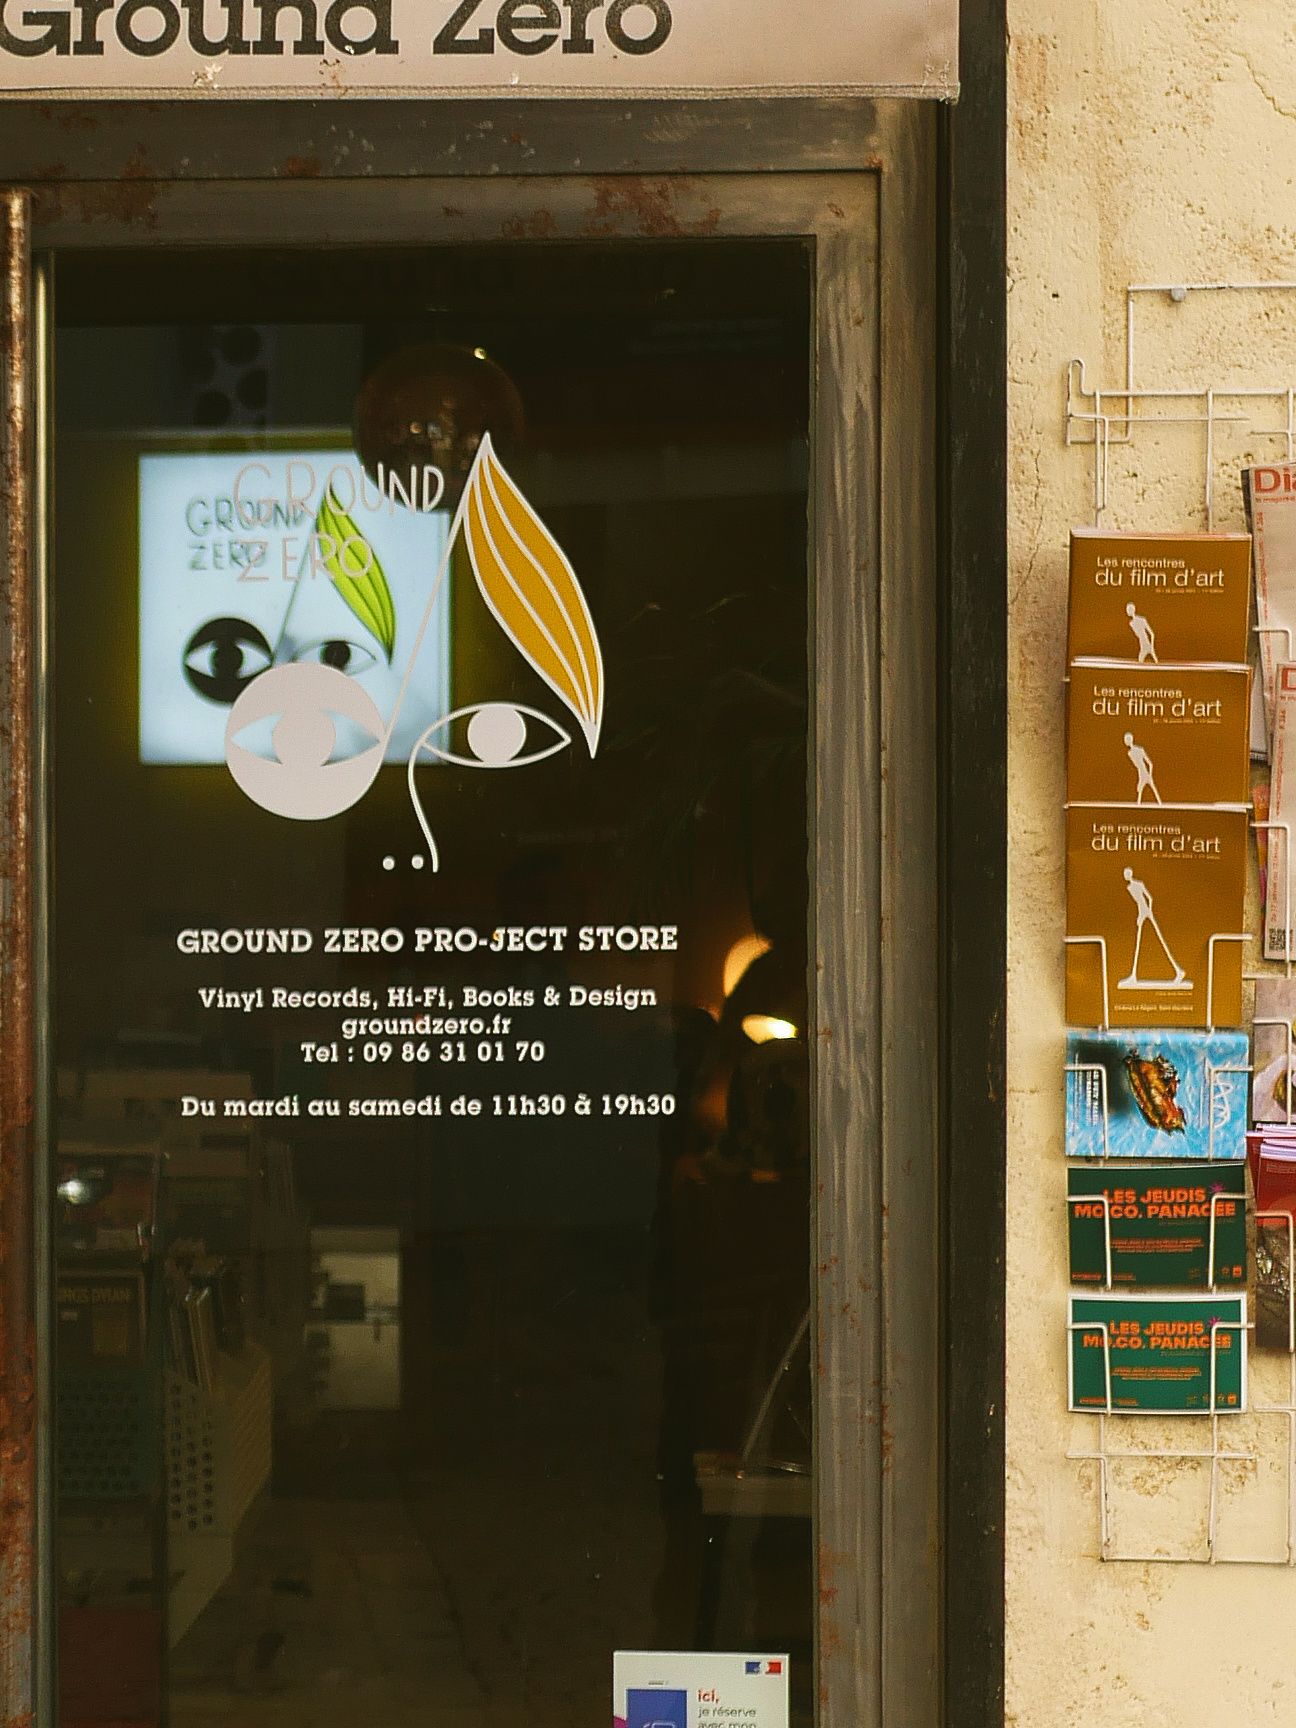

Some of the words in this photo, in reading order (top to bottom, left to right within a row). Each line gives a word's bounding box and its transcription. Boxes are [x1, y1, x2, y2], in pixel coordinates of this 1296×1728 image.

[1254, 465, 1296, 493] Di
[234, 458, 446, 526] GROUND
[184, 496, 309, 537] GROUND
[188, 540, 267, 572] ZERO
[237, 532, 372, 584] ZERO
[1097, 556, 1118, 568] Les
[1122, 557, 1186, 568] rencontres
[1096, 568, 1122, 587] du
[1130, 569, 1167, 587] film
[1174, 569, 1225, 588] d'art
[1093, 685, 1115, 697] Les
[1118, 687, 1183, 698] rencontres
[1093, 697, 1119, 715] du
[1127, 698, 1163, 716] film
[1171, 698, 1222, 717] d'art
[1092, 823, 1114, 834] Les
[1117, 824, 1181, 835] rencontres
[1091, 834, 1119, 851] du
[1126, 834, 1163, 852] film
[1171, 834, 1221, 853] d'art
[176, 928, 313, 954] GROUND
[324, 928, 404, 953] ZERO
[414, 927, 568, 952] PRO-JECT
[578, 926, 679, 951] STORE
[198, 987, 264, 1013] Vinyl
[271, 987, 379, 1010] Records,
[387, 987, 454, 1010] Hi-Fi,
[462, 986, 535, 1007] Books
[543, 986, 560, 1006] &
[569, 985, 657, 1011] Design
[341, 1013, 511, 1040] groundzero.fr
[300, 1042, 338, 1063] Tel
[363, 1042, 393, 1063] 09
[401, 1041, 431, 1062] 86
[439, 1041, 466, 1062] 31
[477, 1041, 504, 1062] 01
[515, 1041, 545, 1062] 70
[180, 1096, 215, 1117] Du
[224, 1095, 300, 1117] mardi
[307, 1100, 340, 1116] au
[348, 1095, 442, 1116] samedi
[450, 1095, 482, 1116] de
[492, 1094, 566, 1116] 11h30
[574, 1094, 592, 1115] à
[602, 1094, 677, 1115] 19h30
[1103, 1188, 1137, 1203] LES
[1140, 1187, 1206, 1203] JEUDIS
[1109, 1320, 1140, 1335] LES
[1143, 1320, 1204, 1335] JEUDIS
[697, 1688, 720, 1704] ici,
[698, 1707, 710, 1718] je
[712, 1705, 757, 1718] réserve
